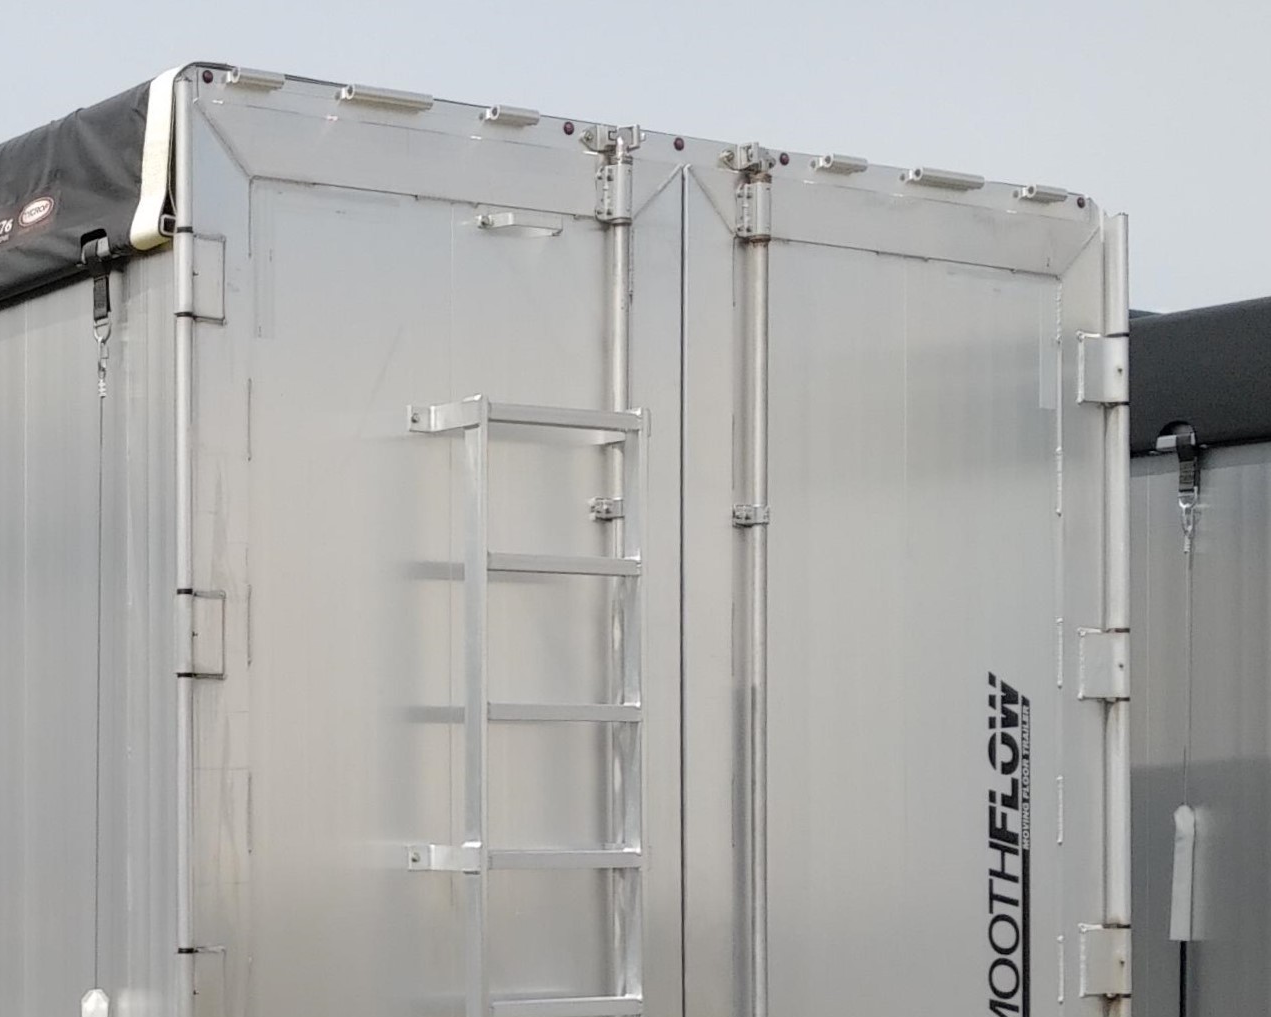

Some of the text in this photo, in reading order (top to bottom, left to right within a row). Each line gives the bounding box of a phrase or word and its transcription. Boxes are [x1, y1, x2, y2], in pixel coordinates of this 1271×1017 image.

[1021, 705, 1030, 851] MOVING FLOOR TRAILER
